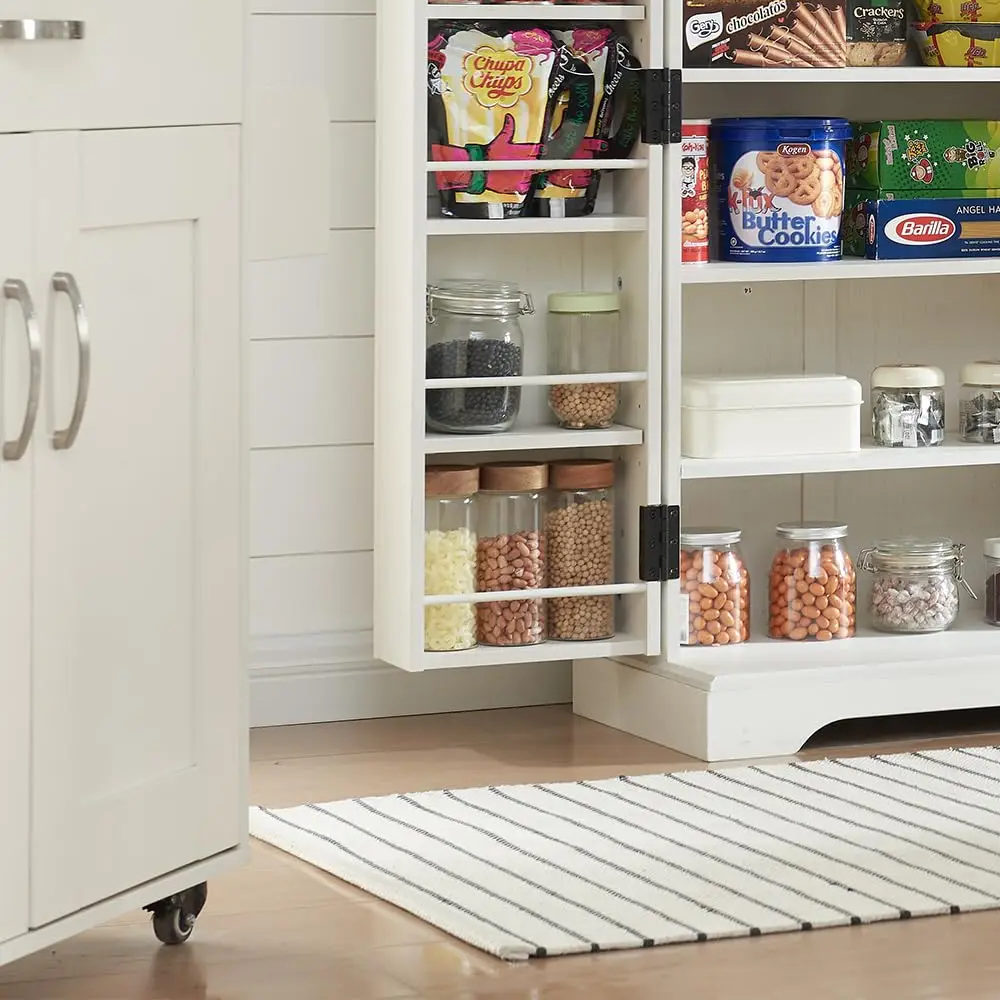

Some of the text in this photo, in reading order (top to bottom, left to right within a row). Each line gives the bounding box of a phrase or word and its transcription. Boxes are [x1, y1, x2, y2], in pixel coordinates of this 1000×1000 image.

[853, 6, 904, 19] Crackers
[473, 56, 526, 77] Chupa
[470, 71, 524, 98] Chups
[782, 145, 807, 154] Kogen
[956, 205, 986, 215] ANGEL
[742, 211, 816, 230] Butter
[901, 220, 950, 237] Barilla
[757, 223, 837, 246] Cookies
